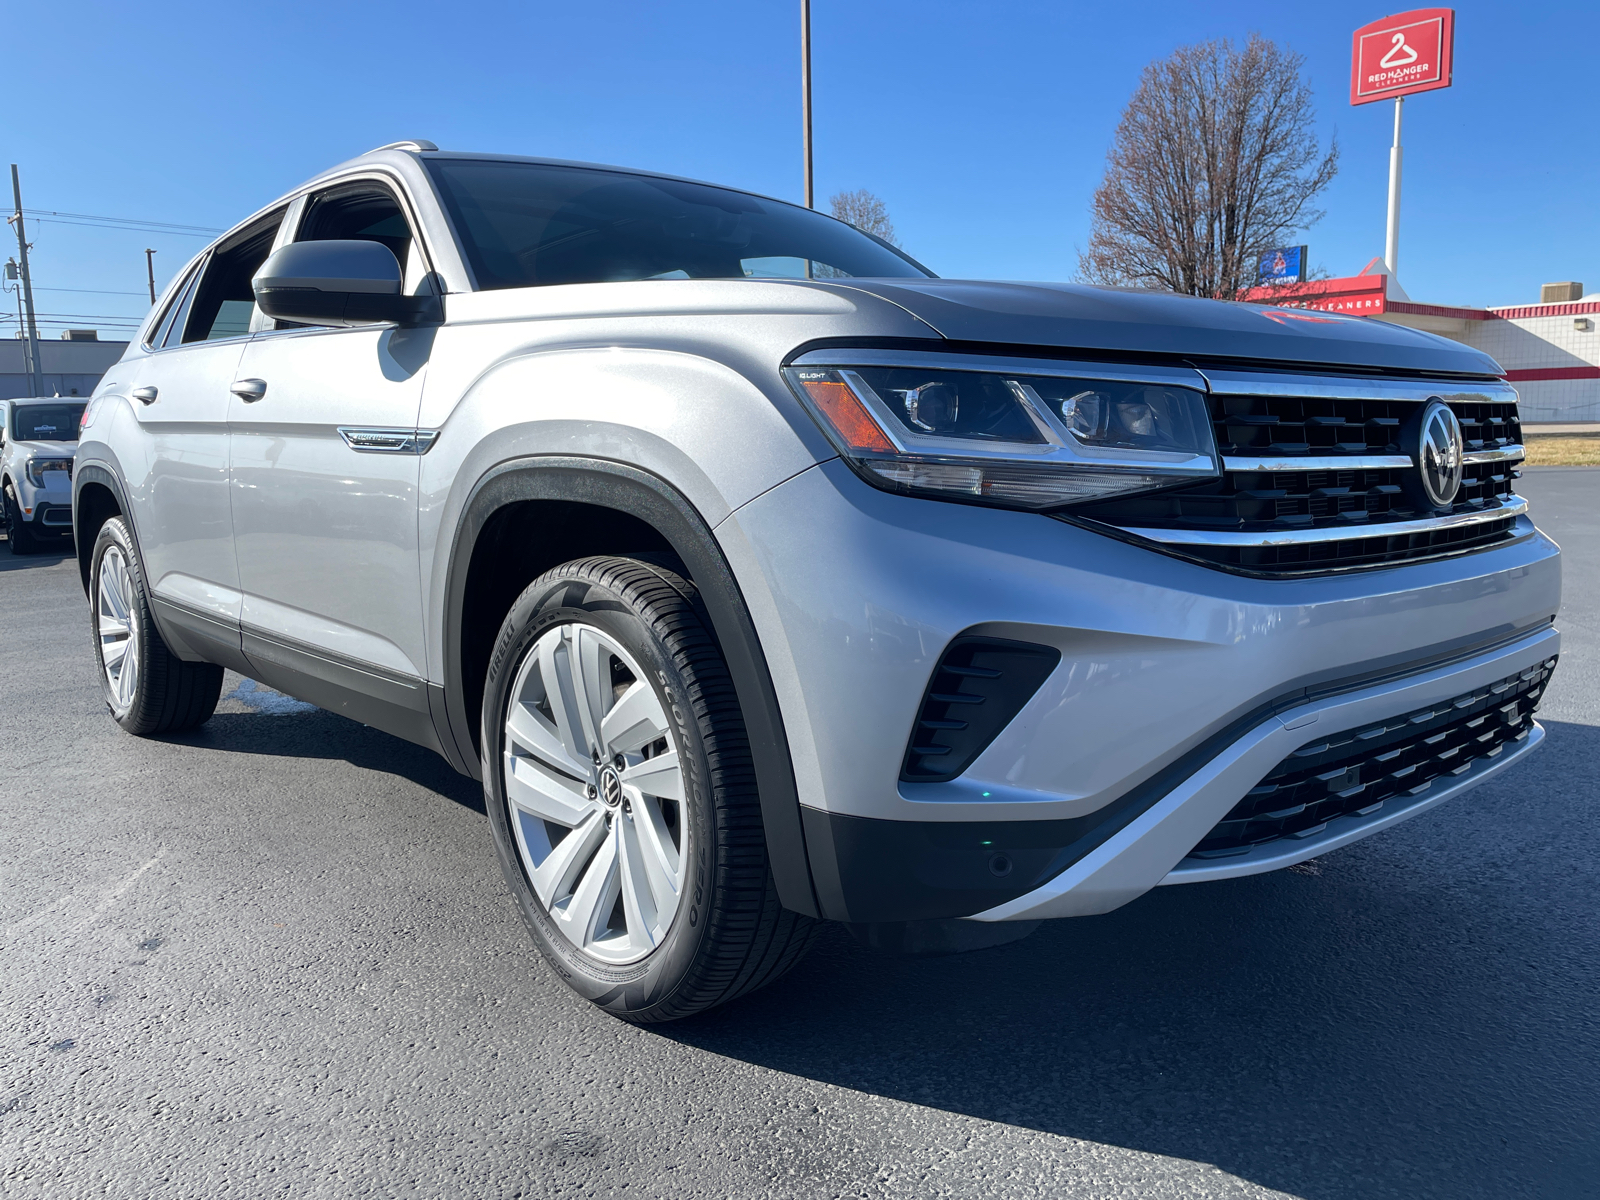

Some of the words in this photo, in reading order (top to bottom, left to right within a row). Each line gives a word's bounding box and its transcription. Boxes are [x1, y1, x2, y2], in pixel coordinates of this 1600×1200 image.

[1368, 72, 1387, 83] RED
[1388, 63, 1429, 78] HANGER
[1376, 74, 1420, 87] CLEANERS
[488, 618, 516, 684] PIRELLI
[654, 670, 706, 832] SCORPION
[689, 838, 706, 928] ZERO
